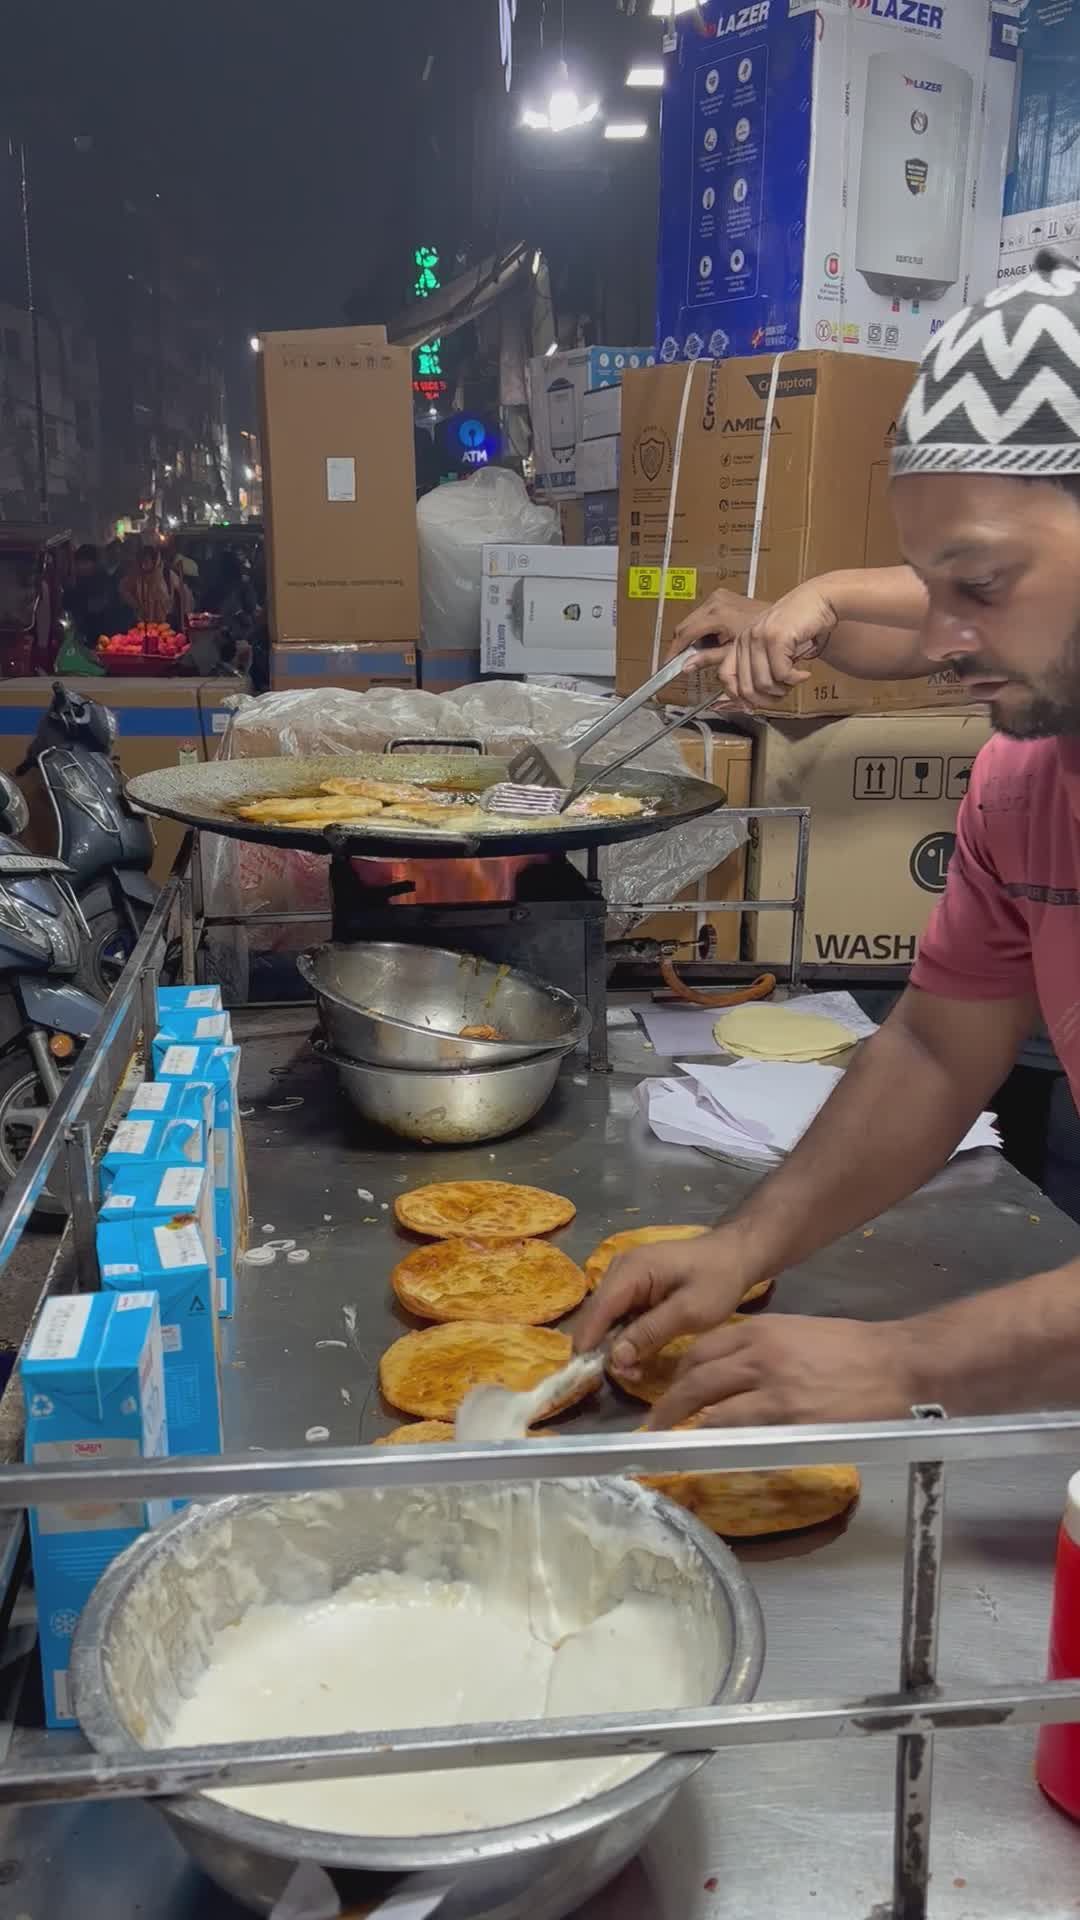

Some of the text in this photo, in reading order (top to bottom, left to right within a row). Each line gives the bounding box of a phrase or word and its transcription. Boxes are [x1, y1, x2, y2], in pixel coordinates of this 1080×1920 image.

[716, 1, 770, 38] LAZER
[870, 0, 944, 30] LAZER
[913, 78, 943, 94] LAZER
[759, 377, 812, 392] Crmpton
[462, 450, 488, 463] ATM
[814, 684, 839, 700] 15 L
[815, 934, 917, 960] WASH
